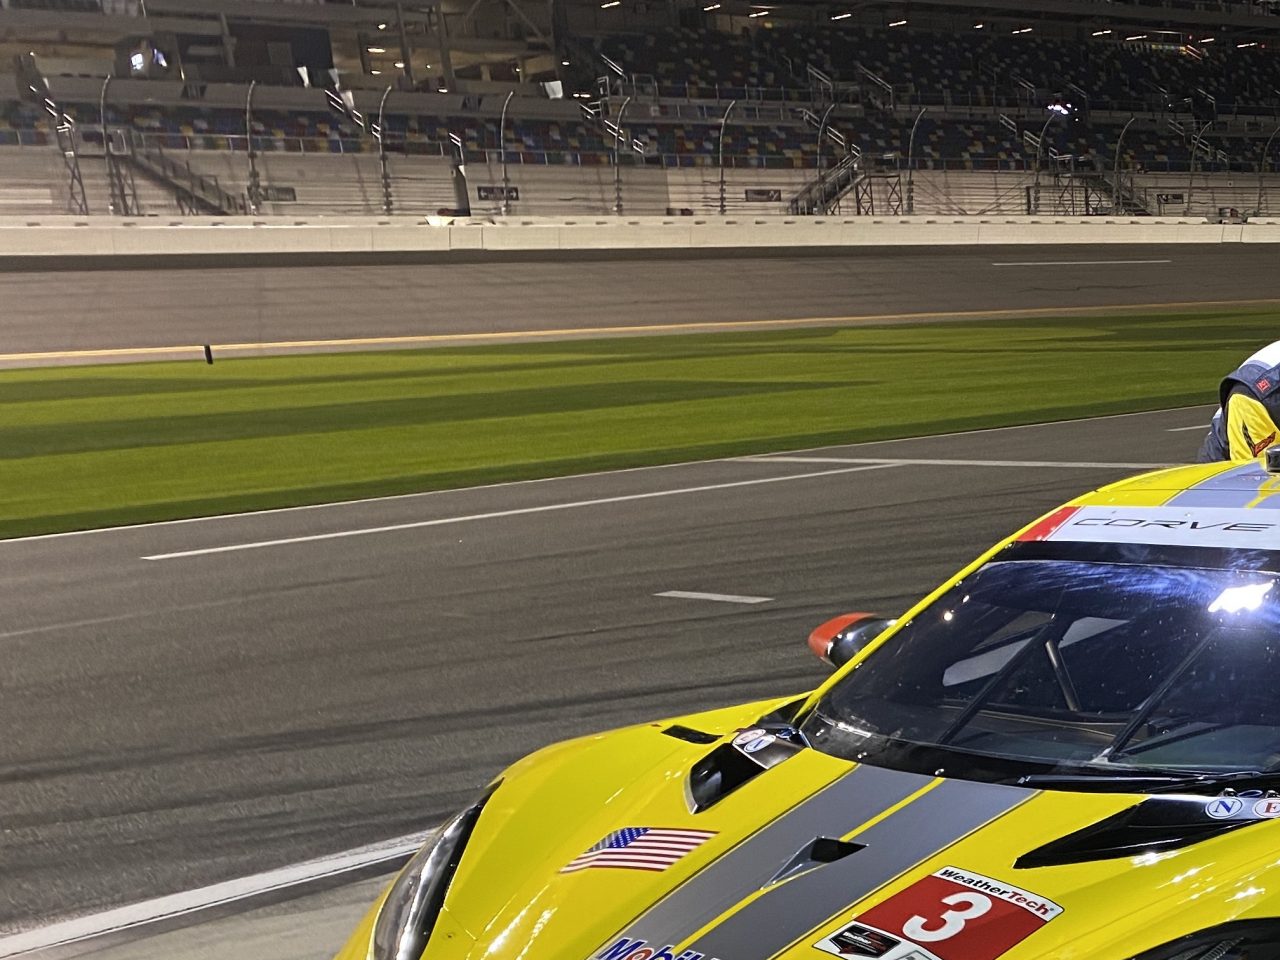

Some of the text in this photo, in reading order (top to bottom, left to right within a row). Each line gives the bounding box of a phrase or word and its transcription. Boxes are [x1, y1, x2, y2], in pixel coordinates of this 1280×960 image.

[1213, 801, 1237, 813] N
[940, 868, 1050, 916] WeatherTech
[902, 891, 992, 942] 3
